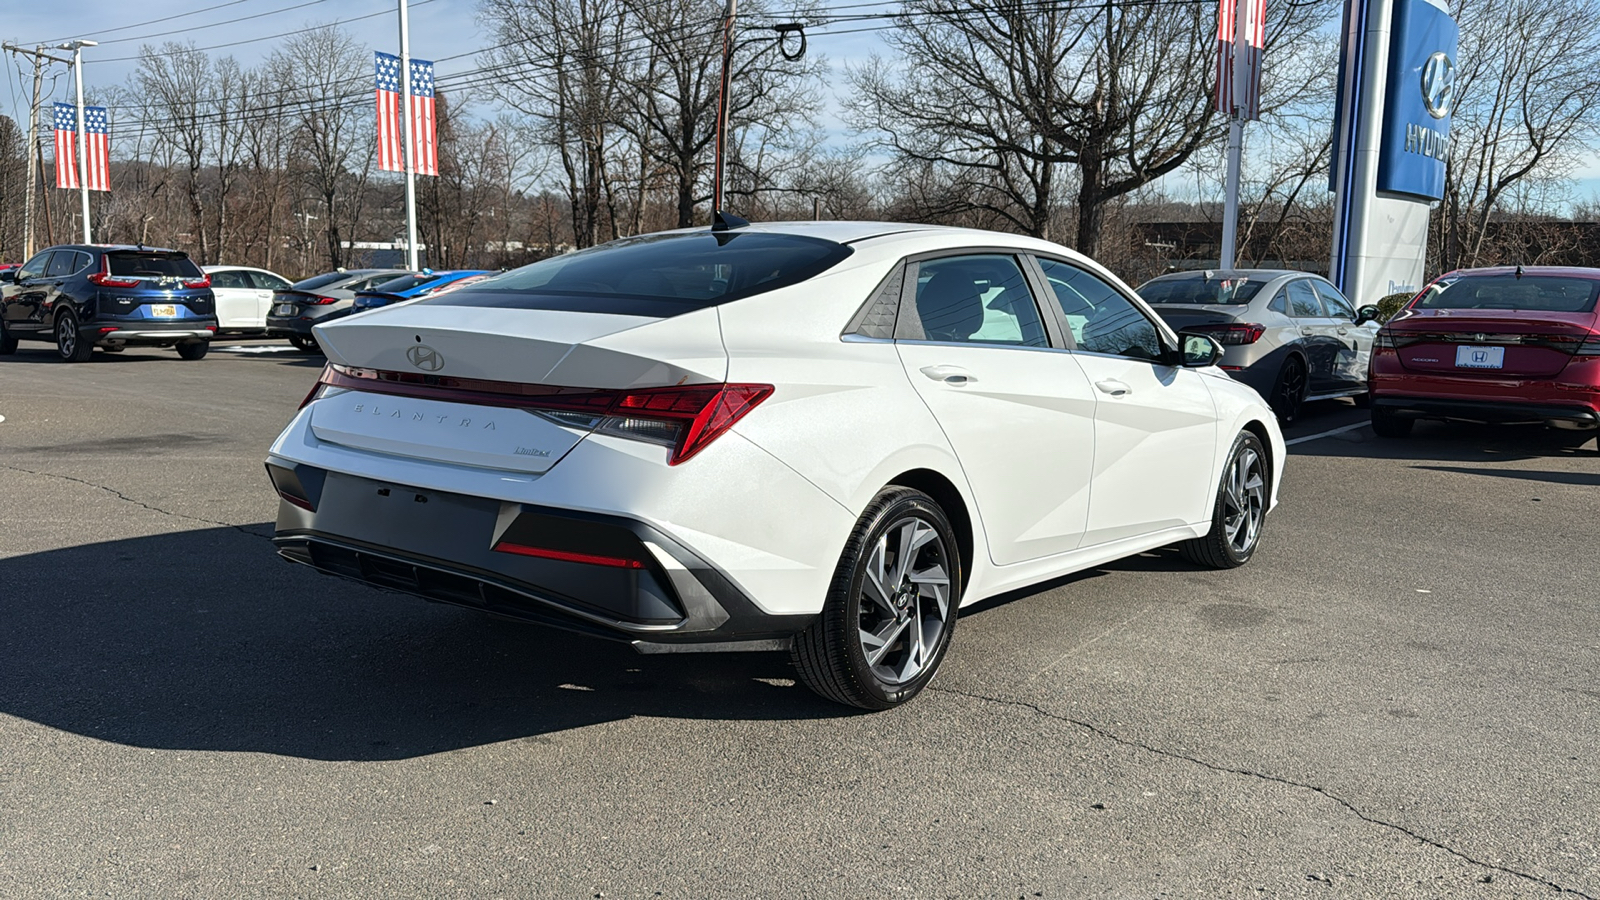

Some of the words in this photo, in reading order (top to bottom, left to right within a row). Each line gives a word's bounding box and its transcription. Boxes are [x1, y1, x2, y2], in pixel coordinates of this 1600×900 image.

[1404, 122, 1449, 163] HYUNDA
[354, 403, 497, 431] ELANTRA
[513, 446, 553, 458] Limited
